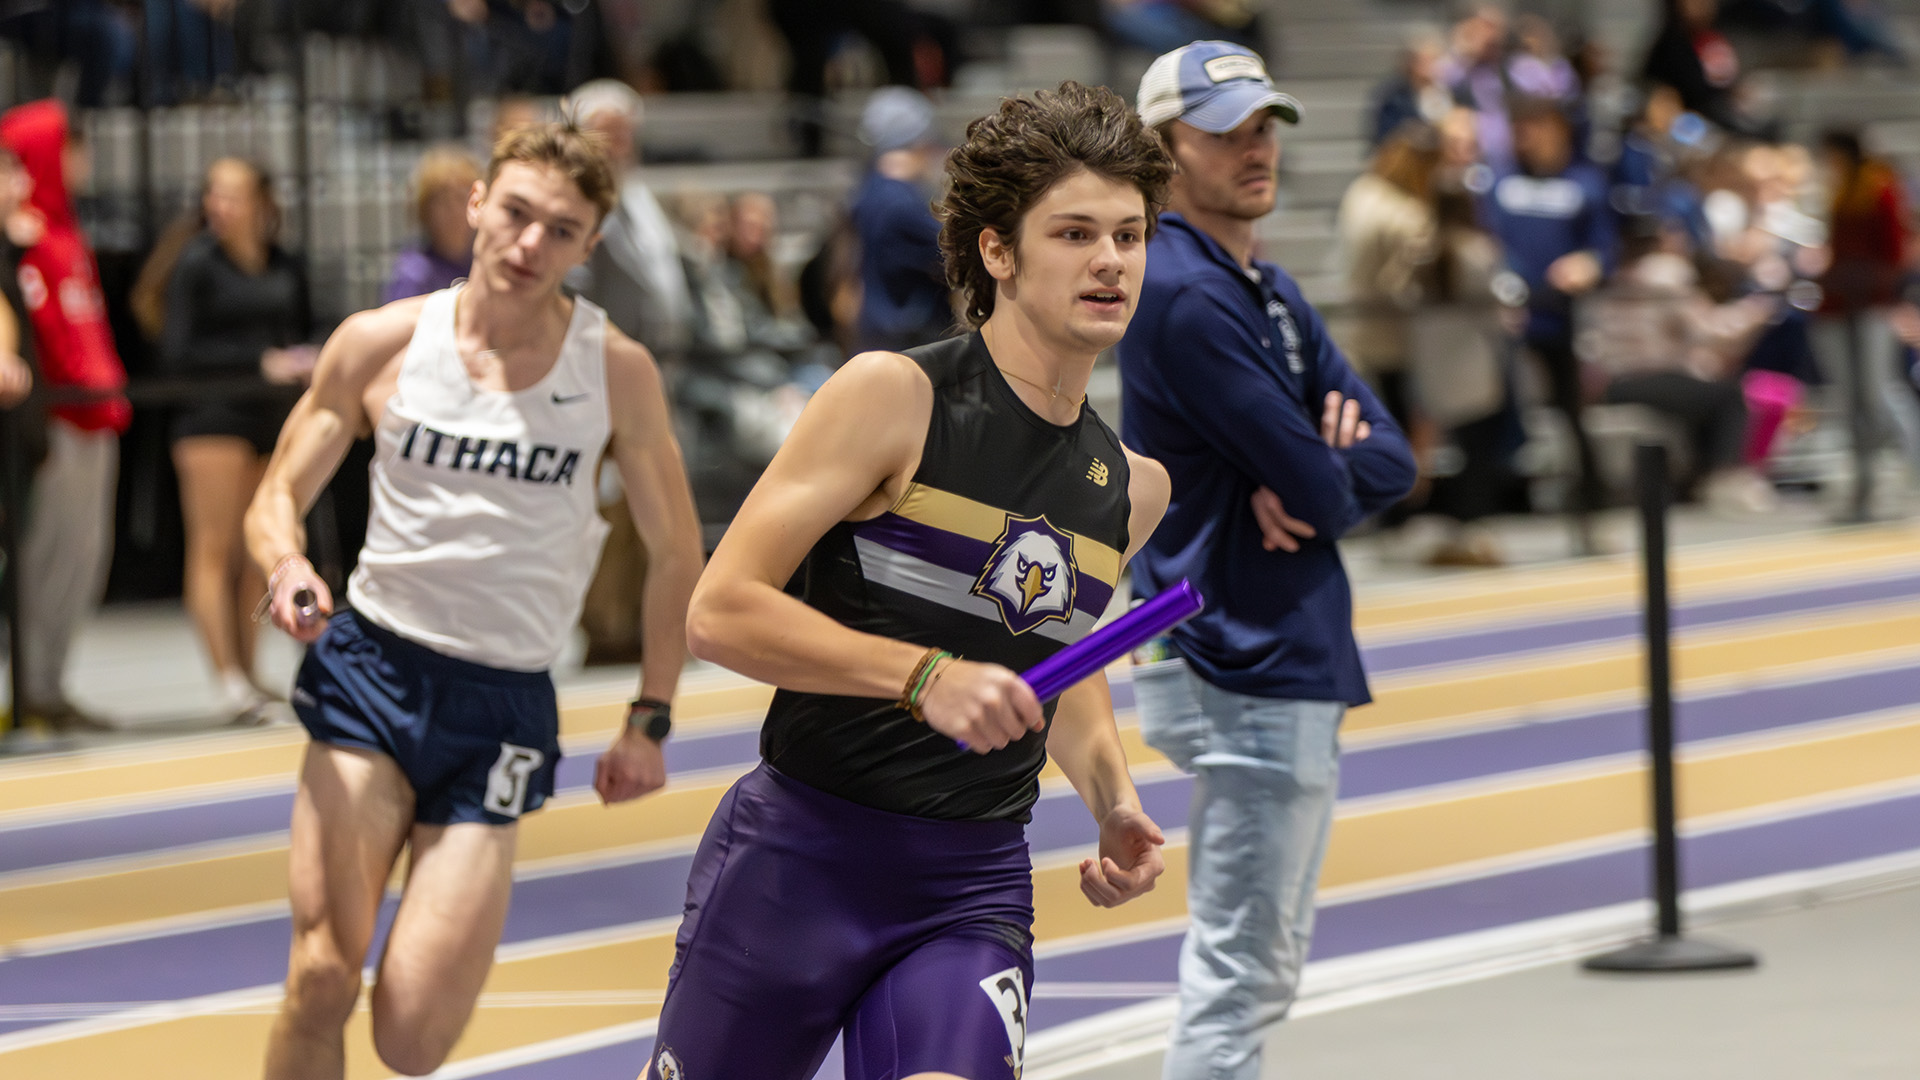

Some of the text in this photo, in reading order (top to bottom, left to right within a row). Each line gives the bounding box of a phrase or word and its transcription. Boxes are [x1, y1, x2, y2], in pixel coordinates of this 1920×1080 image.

[402, 424, 580, 486] ITHACA
[497, 754, 531, 806] 5
[996, 977, 1025, 1061] 3
